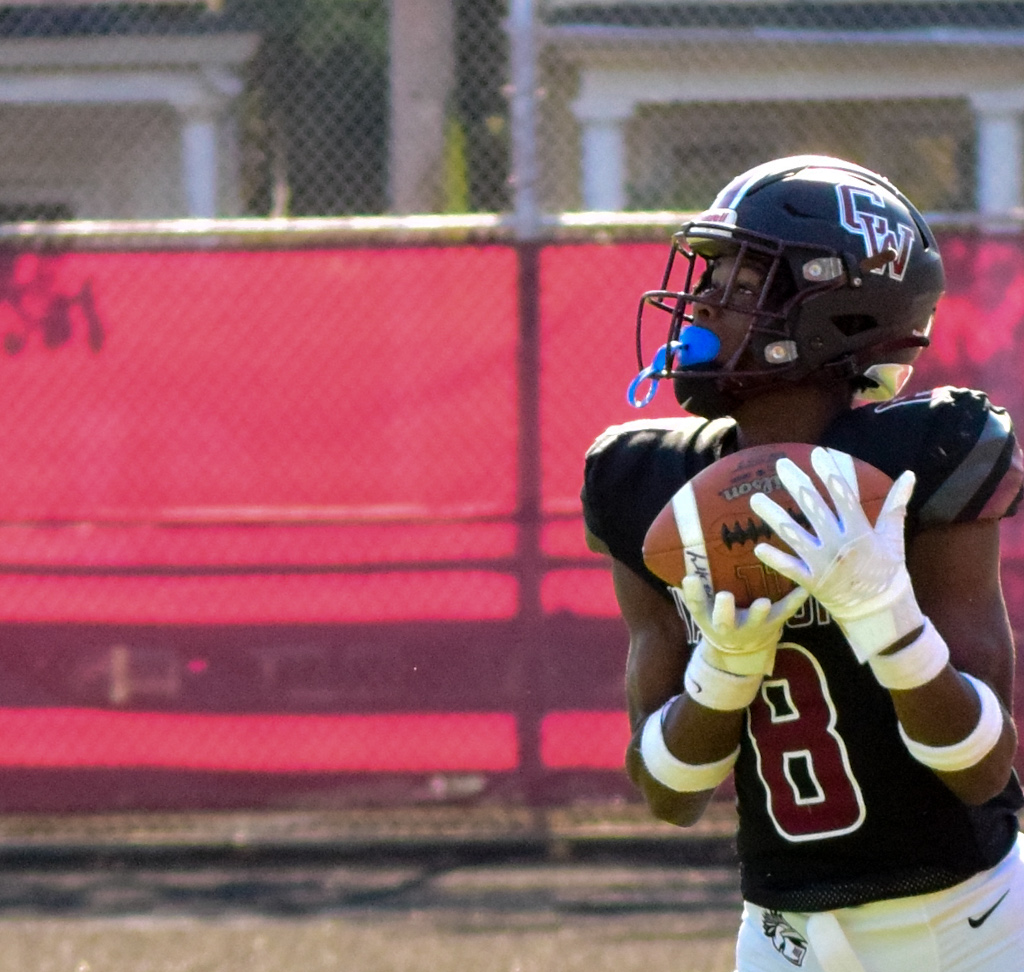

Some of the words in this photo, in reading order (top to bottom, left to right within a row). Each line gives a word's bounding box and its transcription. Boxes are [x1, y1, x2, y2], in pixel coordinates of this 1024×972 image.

[836, 182, 915, 282] CW
[723, 474, 786, 501] ilson
[748, 642, 867, 842] 8
